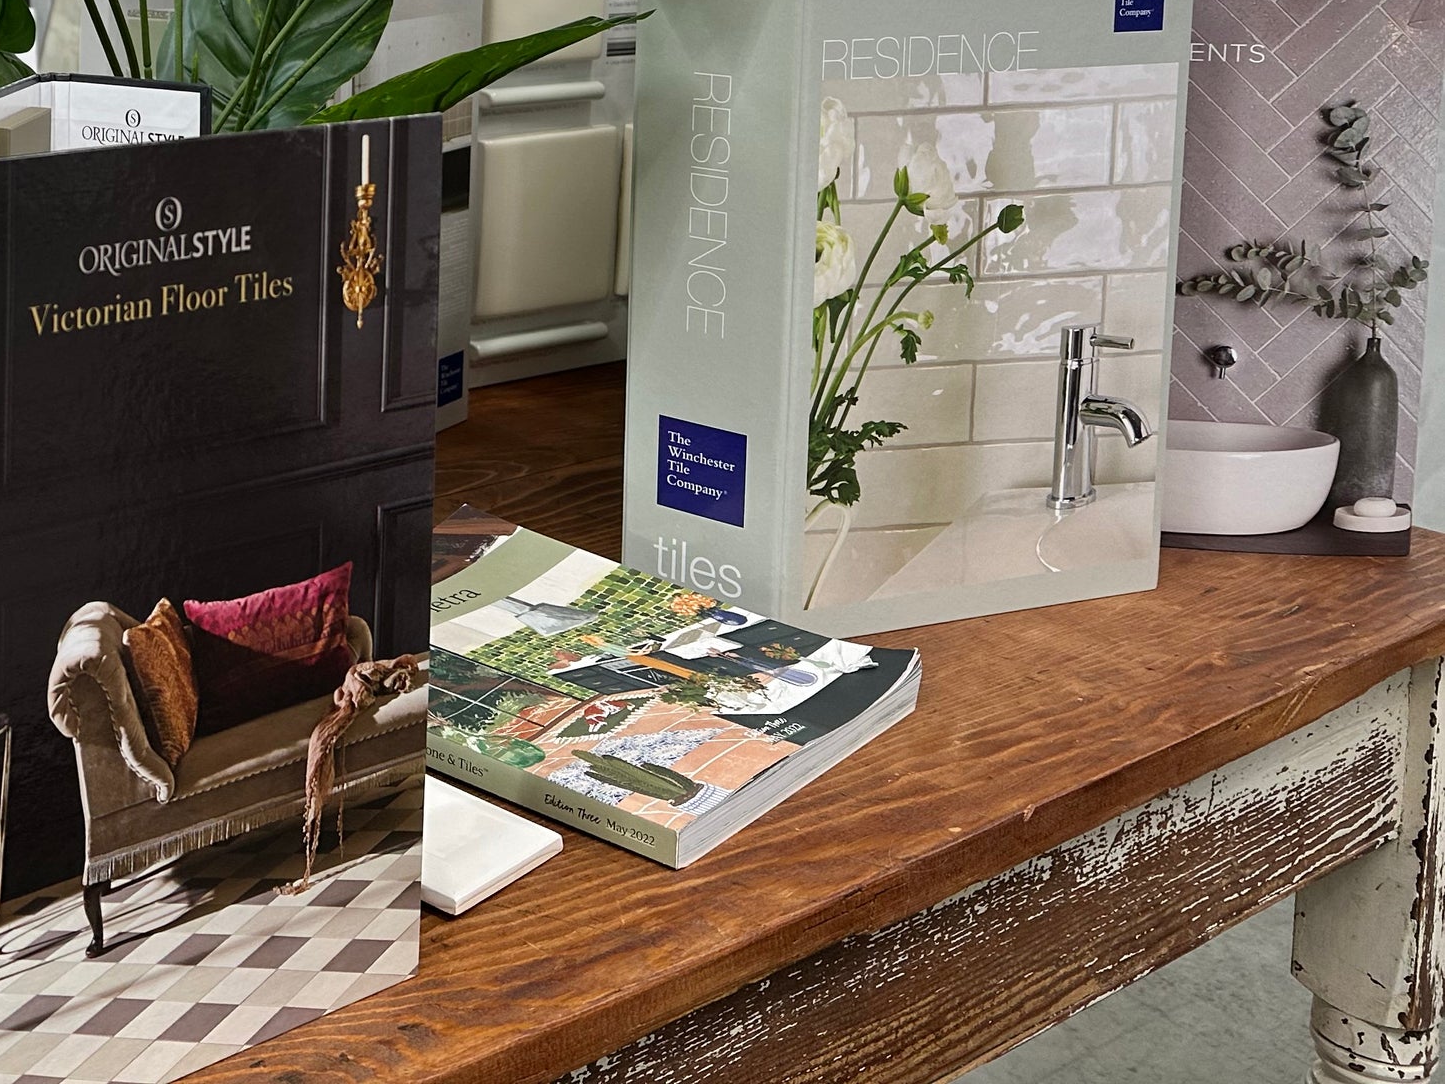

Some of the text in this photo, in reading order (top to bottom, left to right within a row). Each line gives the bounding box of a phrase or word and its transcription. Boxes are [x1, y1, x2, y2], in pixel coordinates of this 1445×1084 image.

[821, 31, 1040, 81] RESIDENCE
[686, 71, 732, 340] RESIDENCE
[29, 271, 294, 336] Victorian Floor Tiles
[667, 430, 691, 447] The
[668, 445, 736, 473] Winchester
[667, 459, 691, 476] Tile
[653, 536, 742, 599] tiles
[447, 753, 456, 766] &
[544, 794, 656, 847] Edition Three May 2022
